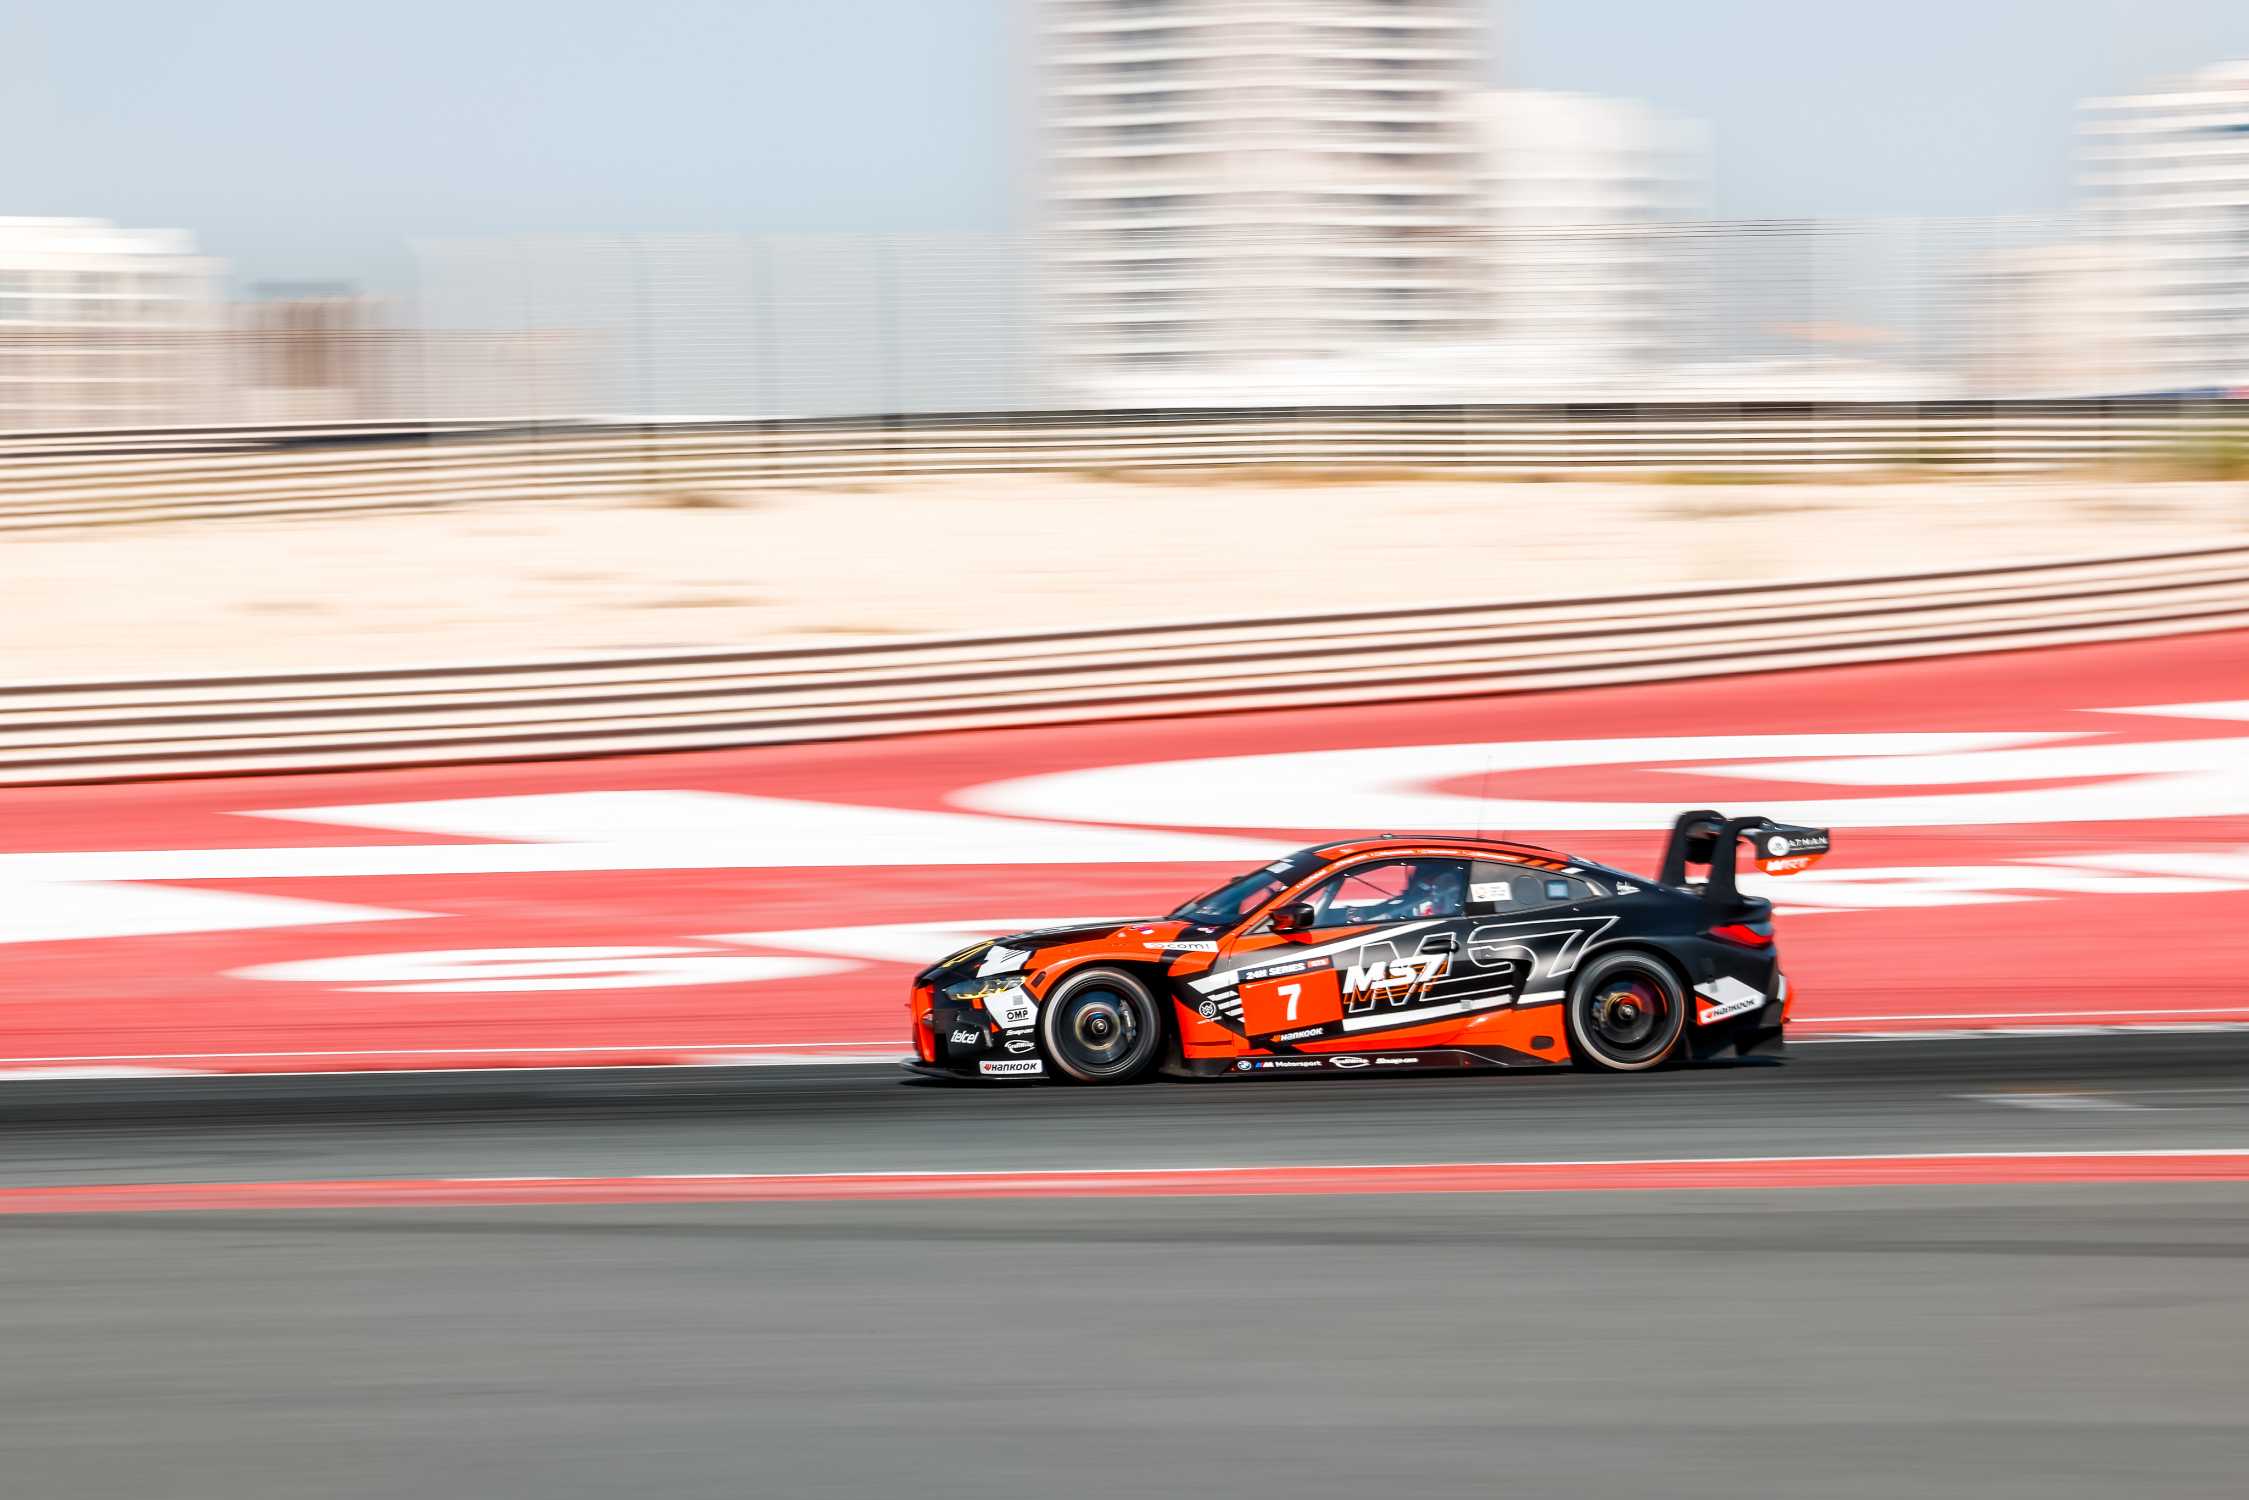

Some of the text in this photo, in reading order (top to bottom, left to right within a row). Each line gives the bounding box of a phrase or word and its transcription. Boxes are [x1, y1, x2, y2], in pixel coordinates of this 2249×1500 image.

[1343, 954, 1449, 994] MS7
[1278, 983, 1302, 1021] 7
[1006, 1009, 1029, 1020] OMP
[1275, 1060, 1323, 1068] Motorsport
